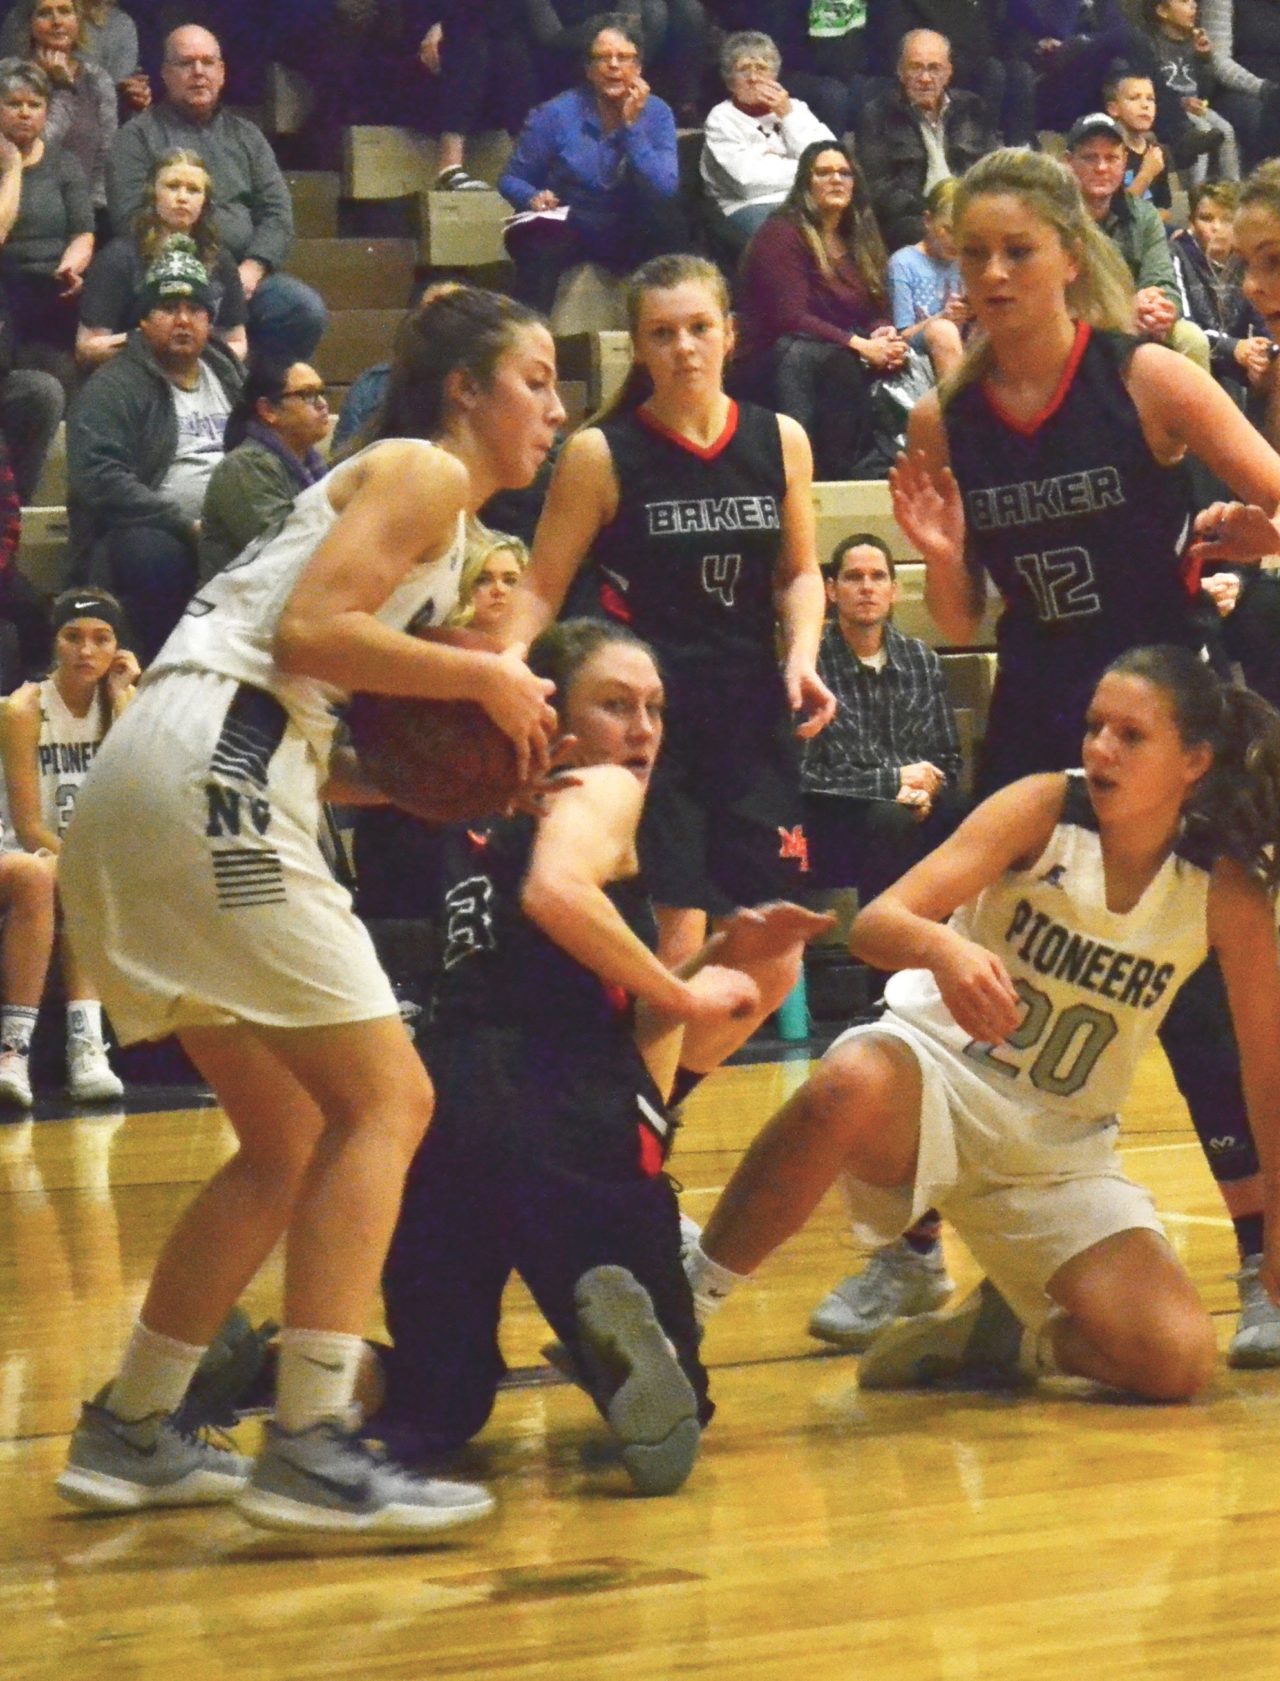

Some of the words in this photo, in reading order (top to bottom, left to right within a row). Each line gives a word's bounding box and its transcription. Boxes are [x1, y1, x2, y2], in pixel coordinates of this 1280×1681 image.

[645, 496, 781, 534] BAKER
[964, 466, 1128, 531] BAKER
[702, 554, 741, 606] 4
[1014, 546, 1102, 622] 12
[1004, 898, 1175, 1010] PIONEERS
[962, 976, 1119, 1097] 20
